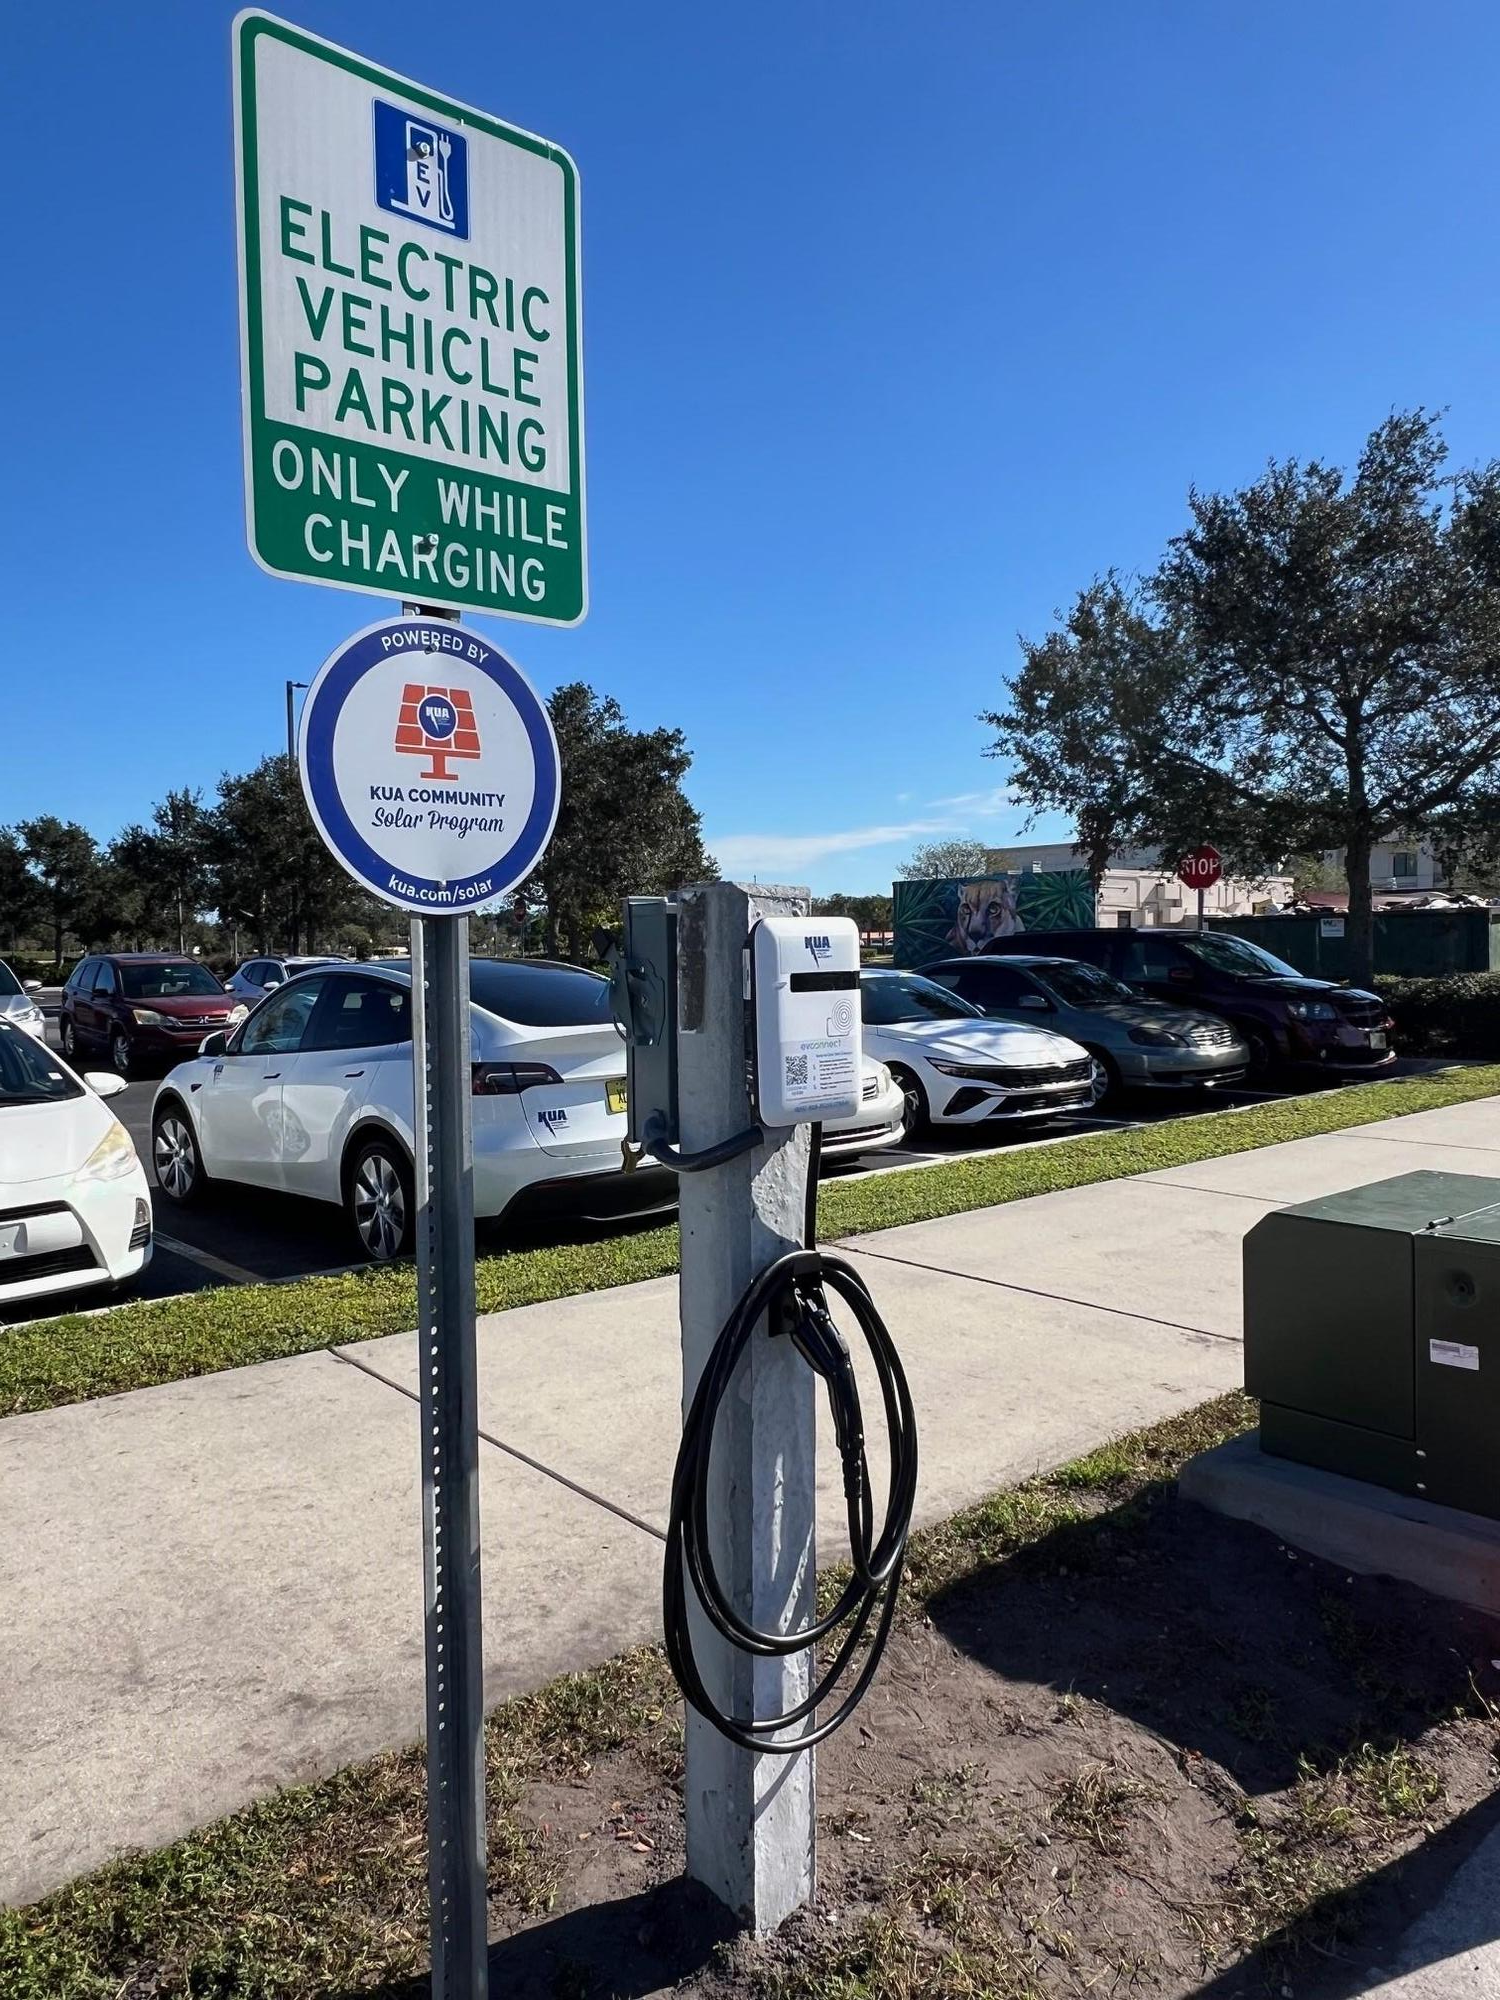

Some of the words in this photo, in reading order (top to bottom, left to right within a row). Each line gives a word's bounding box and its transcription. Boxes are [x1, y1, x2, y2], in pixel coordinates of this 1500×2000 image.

[416, 161, 432, 209] EV
[279, 194, 551, 343] ELECTRIC
[295, 275, 542, 408] VEHICLE
[294, 350, 547, 473] PARKING
[271, 438, 411, 513] ONLY
[436, 477, 569, 550] WHILE
[303, 512, 546, 602] CHARGING
[381, 630, 463, 651] POWERED
[467, 643, 489, 663] BY
[425, 706, 450, 718] KUA
[370, 785, 405, 802] KUA
[408, 788, 506, 808] COMMUNITY
[371, 807, 423, 829] Solar
[427, 810, 505, 839] Program
[388, 873, 493, 904] kua.com/solar
[804, 936, 831, 949] KUA
[537, 1109, 568, 1123] KUA
